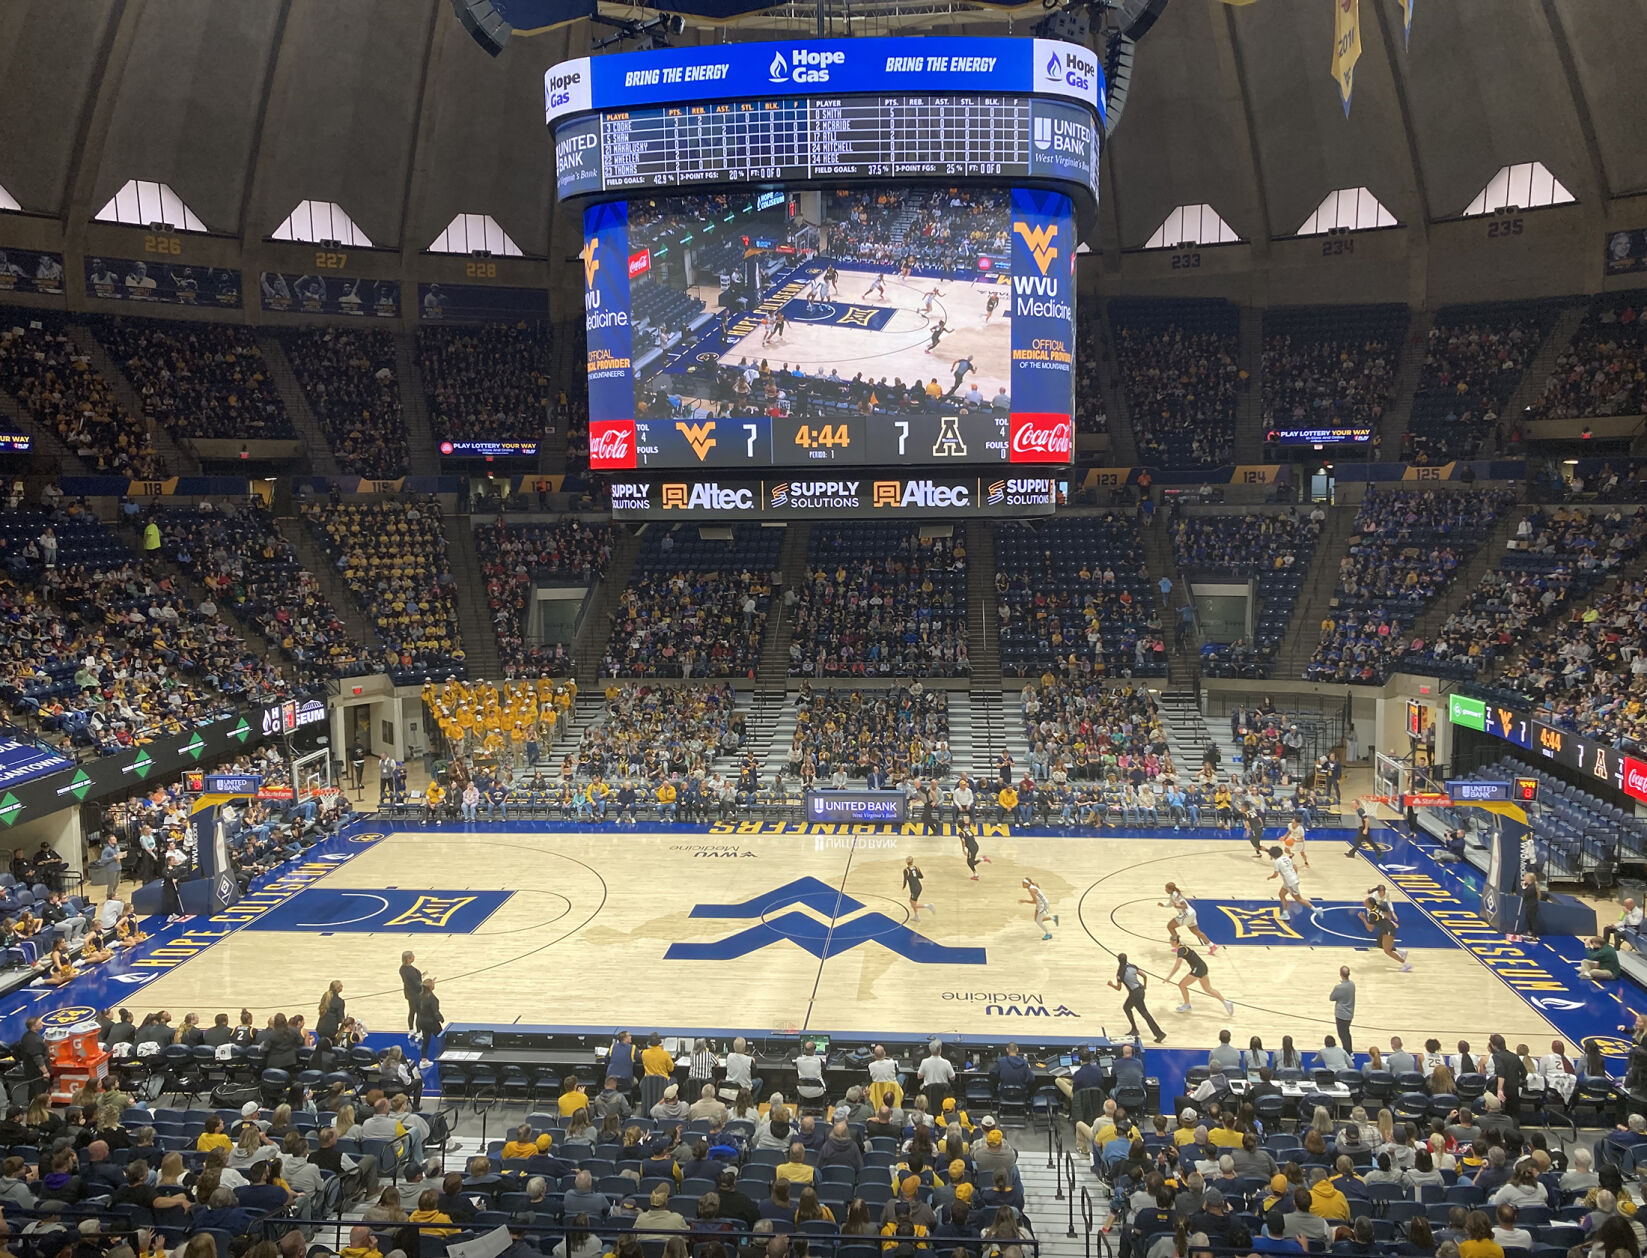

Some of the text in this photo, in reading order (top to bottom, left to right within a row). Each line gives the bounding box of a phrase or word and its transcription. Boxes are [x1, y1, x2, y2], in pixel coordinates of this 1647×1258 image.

[792, 50, 845, 68] Hope
[886, 57, 997, 72] BRING THE ENERGY
[1066, 53, 1094, 77] Hope
[550, 72, 581, 92] Hope
[625, 64, 729, 87] BRING THE ENERGY
[792, 67, 829, 83] Gas
[1066, 72, 1089, 90] Gas
[550, 92, 570, 108] Gas
[822, 108, 842, 119] SMITH
[1054, 119, 1091, 143] UNITED
[558, 134, 597, 157] UNITED
[1054, 136, 1085, 156] BANK
[560, 152, 583, 172] BANK
[1035, 153, 1054, 163] West
[1488, 220, 1523, 238] 235
[145, 236, 181, 255] 226
[1323, 240, 1354, 256] 234
[315, 253, 347, 269] 227
[1172, 254, 1200, 269] 233
[466, 263, 496, 278] 228
[1014, 276, 1058, 296] WVU
[587, 310, 628, 332] edicine.
[1032, 339, 1066, 352] OFFICIAL
[1013, 350, 1049, 360] MEDICAL
[597, 358, 630, 370] PROVIDER
[641, 434, 646, 442] 4
[795, 425, 850, 448] 4:44
[894, 422, 909, 454] 7
[1000, 428, 1005, 436] 4
[743, 424, 757, 458] 7
[1096, 474, 1118, 485] 123
[1243, 472, 1266, 483] 124
[1416, 468, 1440, 480] 125
[144, 483, 162, 495] 118
[532, 481, 552, 492] 10
[612, 484, 650, 497] SUPPLY
[790, 482, 859, 496] SUPPLY
[1007, 478, 1049, 493] SUPPLY
[791, 498, 859, 508] SOLUTIONS
[1007, 494, 1049, 505] SOLUTIONS
[1520, 722, 1526, 742] 7
[1540, 727, 1562, 752] 4:44
[1577, 745, 1584, 768] 7
[1524, 789, 1532, 798] 8
[826, 802, 897, 811] UNITED BANK
[131, 862, 339, 967] HOPE COLISEUM
[1389, 874, 1569, 992] HOPE COLISEUM
[942, 992, 1043, 1004] Medicine
[985, 1005, 1050, 1016] WVU
[237, 1031, 244, 1040] 2
[73, 1039, 81, 1049] G
